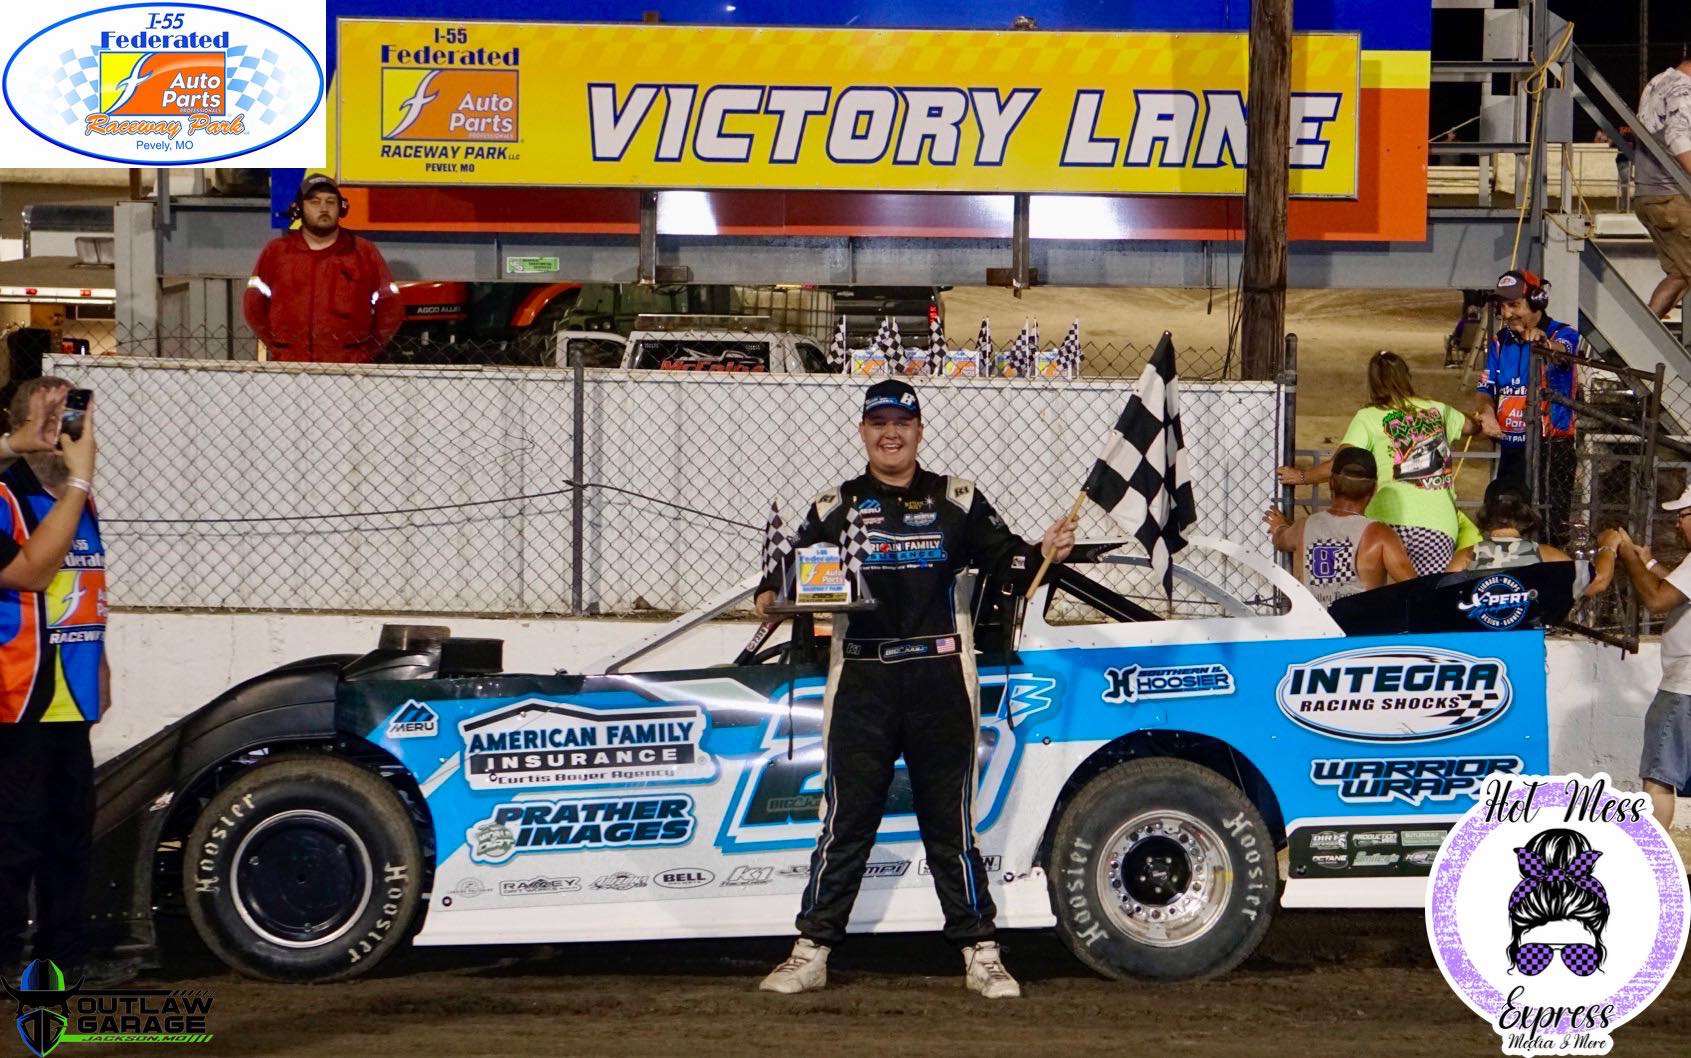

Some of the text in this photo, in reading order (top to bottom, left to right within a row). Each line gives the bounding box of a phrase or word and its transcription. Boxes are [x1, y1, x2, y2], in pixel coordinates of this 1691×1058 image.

[434, 28, 468, 44] I-55
[381, 44, 520, 66] Federated
[458, 92, 513, 112] Auto
[449, 112, 513, 133] Parts
[587, 83, 1343, 170] VICTORY LANE
[381, 145, 460, 158] RACEWAY
[464, 146, 508, 160] PARK
[460, 163, 475, 173] MO
[905, 540, 940, 550] FAMILY
[1137, 674, 1230, 690] HOOSIER
[1289, 663, 1499, 695] INTEGRA
[1300, 696, 1460, 713] RACING SHOCKS
[389, 722, 434, 733] MERU
[469, 721, 694, 754] AMERICAN FAMILY
[485, 748, 678, 771] INSURANCE
[498, 768, 675, 785] Curtis Boyer Agency
[1313, 758, 1518, 784] WARRIOR
[496, 799, 688, 826] PRATHER
[194, 793, 256, 894] Hoosier
[514, 820, 690, 847] IMAGES
[663, 872, 706, 883] BELL
[1222, 811, 1269, 922] Hoosier
[1067, 837, 1110, 948] Hoosier
[348, 861, 409, 964] Hoosier
